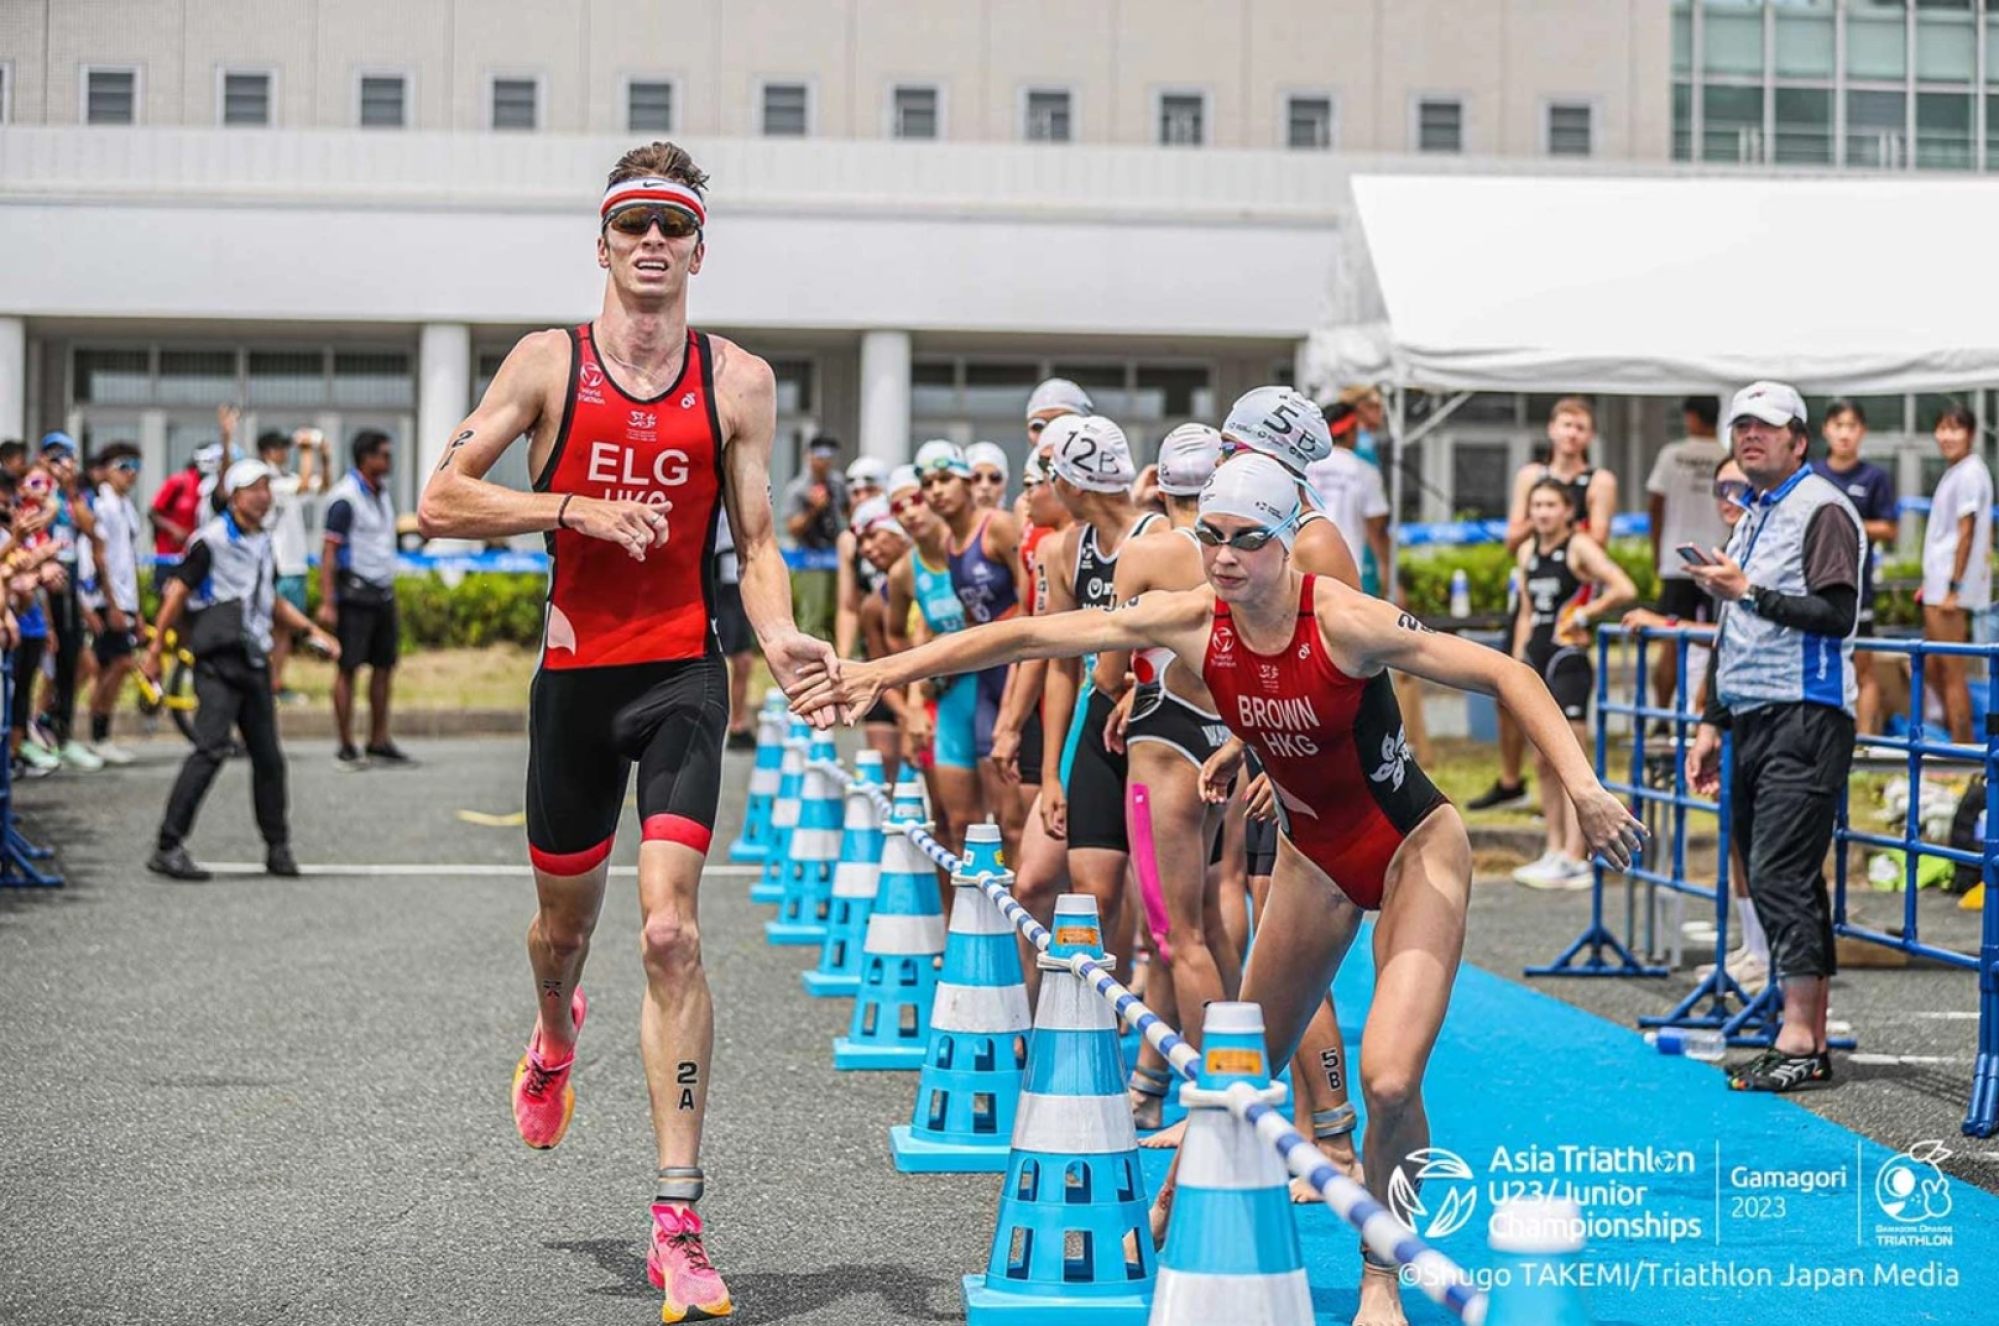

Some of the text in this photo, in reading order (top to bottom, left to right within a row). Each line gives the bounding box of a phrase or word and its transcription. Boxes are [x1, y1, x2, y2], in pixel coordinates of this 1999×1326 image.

[587, 441, 690, 487] ELG
[1237, 695, 1320, 731] BROWN
[1260, 731, 1320, 757] HKG
